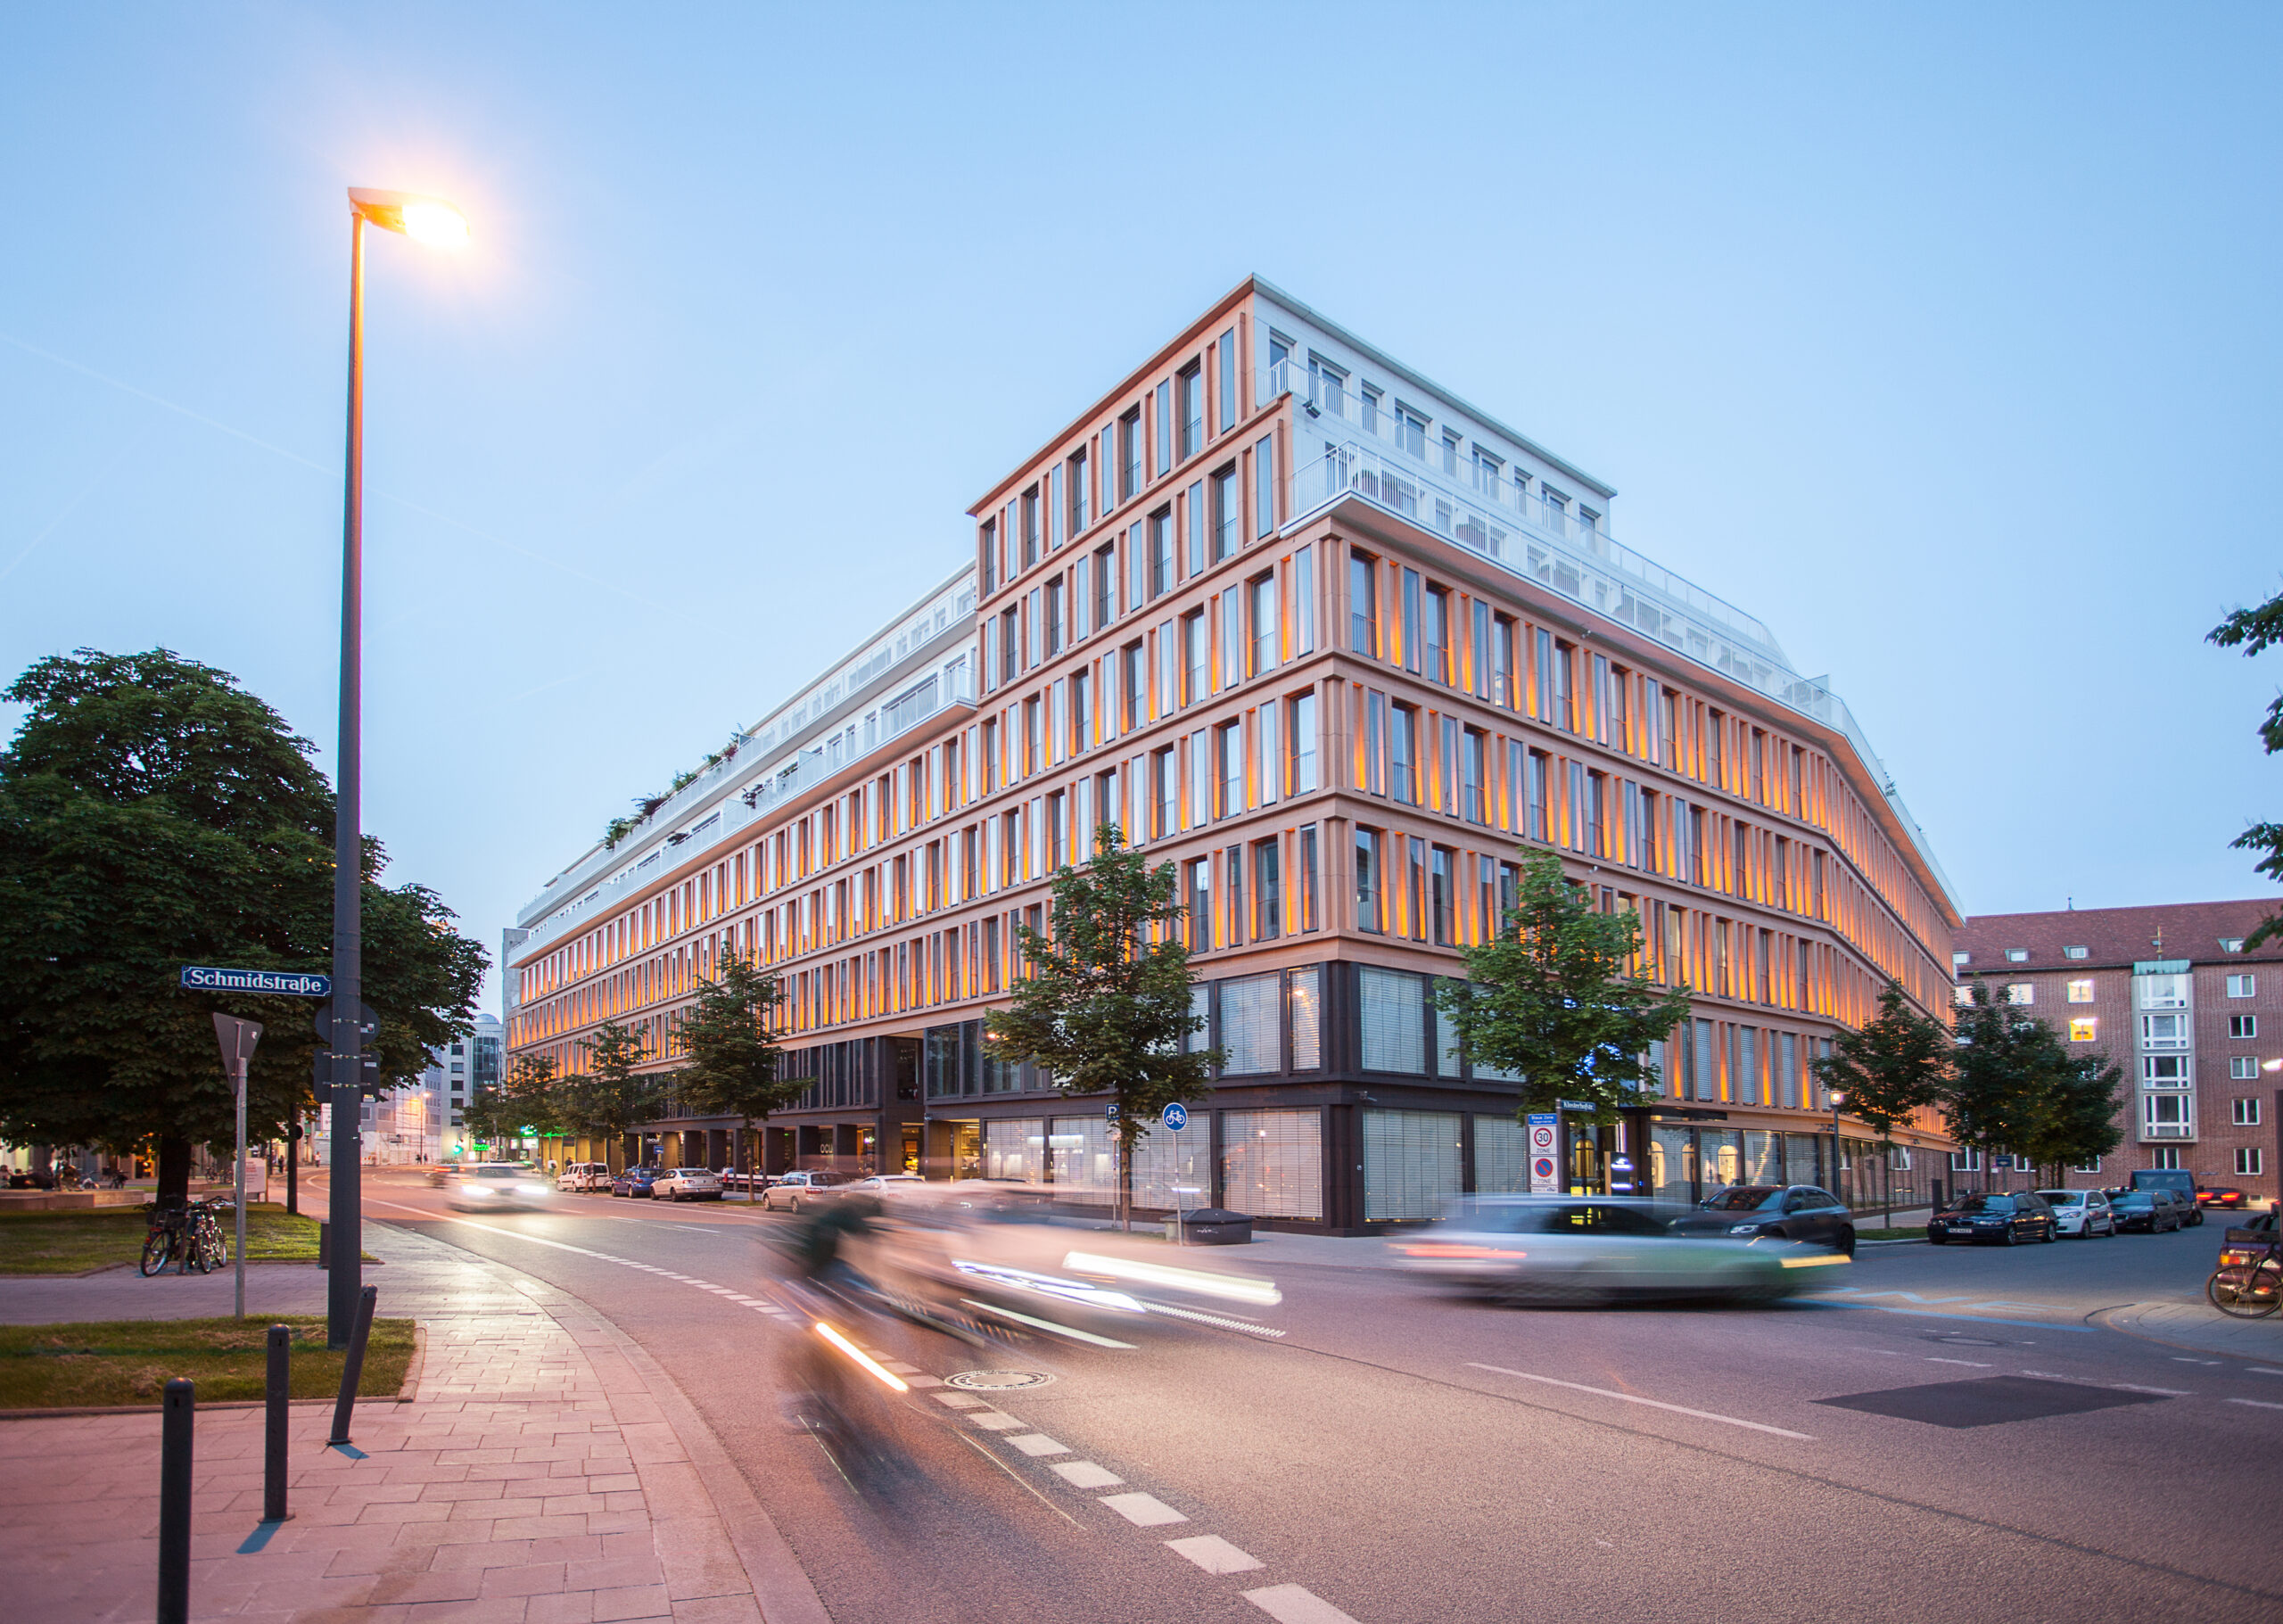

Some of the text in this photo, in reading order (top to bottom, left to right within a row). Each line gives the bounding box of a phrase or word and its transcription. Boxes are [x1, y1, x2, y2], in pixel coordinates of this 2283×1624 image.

[191, 969, 322, 993] Schmidstraße
[1108, 1106, 1118, 1118] P
[1537, 1133, 1549, 1142] 30
